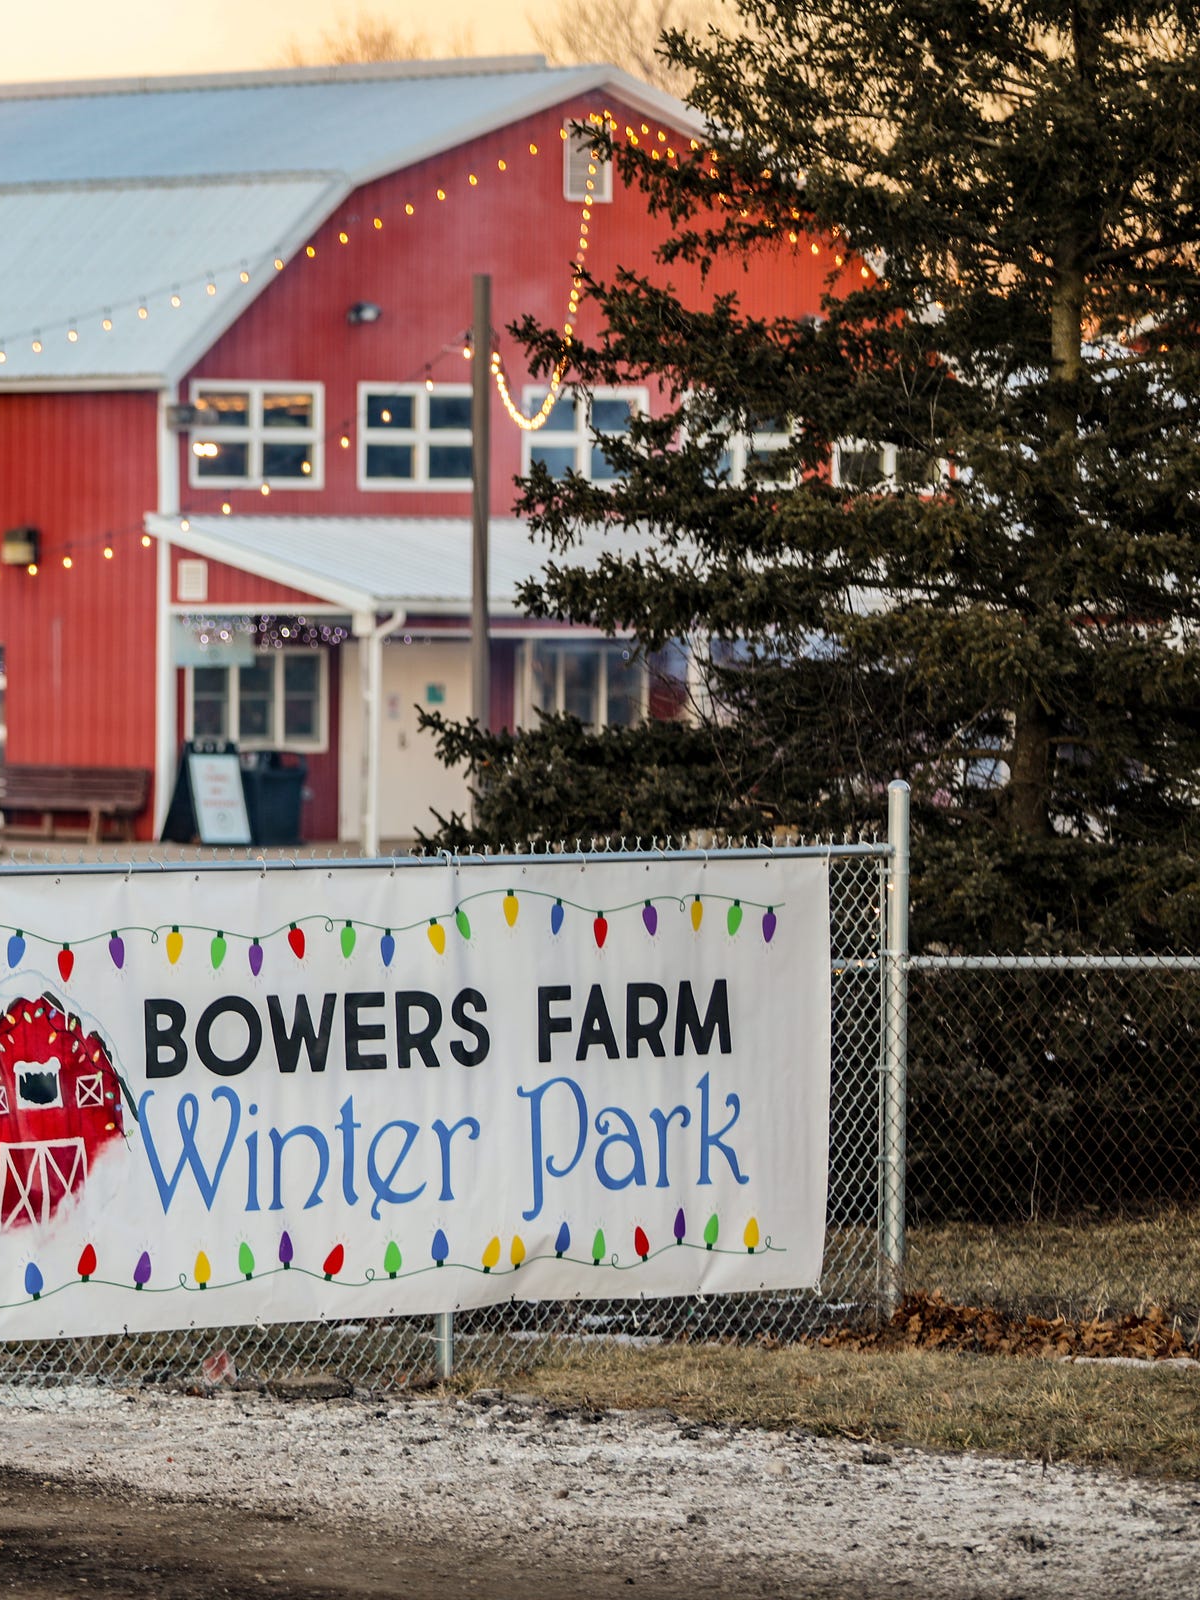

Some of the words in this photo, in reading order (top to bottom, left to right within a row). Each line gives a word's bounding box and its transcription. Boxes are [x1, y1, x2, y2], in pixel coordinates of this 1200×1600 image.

[144, 986, 492, 1079] BOWERS
[536, 978, 733, 1063] FARM
[136, 1085, 481, 1222] Winter
[515, 1071, 750, 1222] Park
